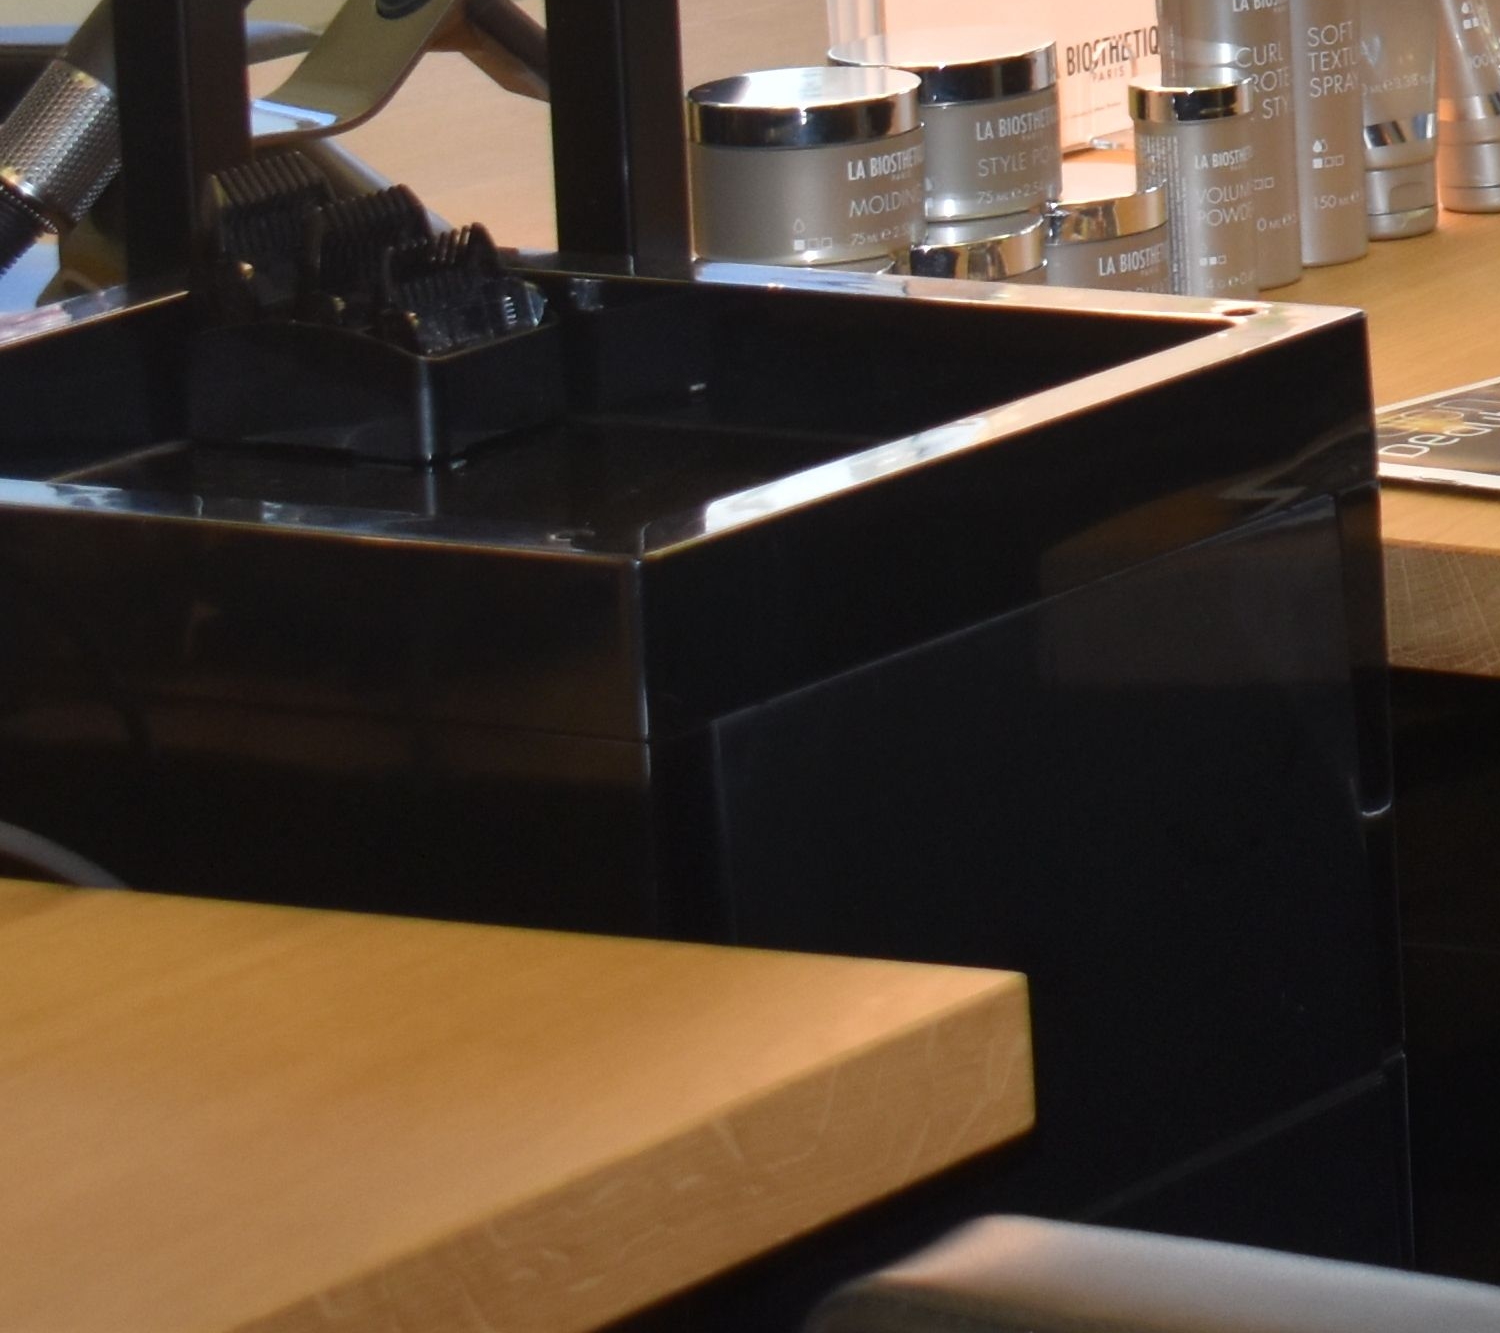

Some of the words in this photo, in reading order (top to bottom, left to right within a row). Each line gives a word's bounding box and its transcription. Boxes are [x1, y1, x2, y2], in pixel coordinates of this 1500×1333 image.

[1307, 21, 1353, 47] SOFT
[1235, 41, 1284, 68] CURL
[976, 121, 994, 141] LA
[847, 160, 866, 181] LA
[978, 153, 1027, 177] STYLE
[1195, 152, 1209, 170] LA
[1098, 256, 1116, 277] LA
